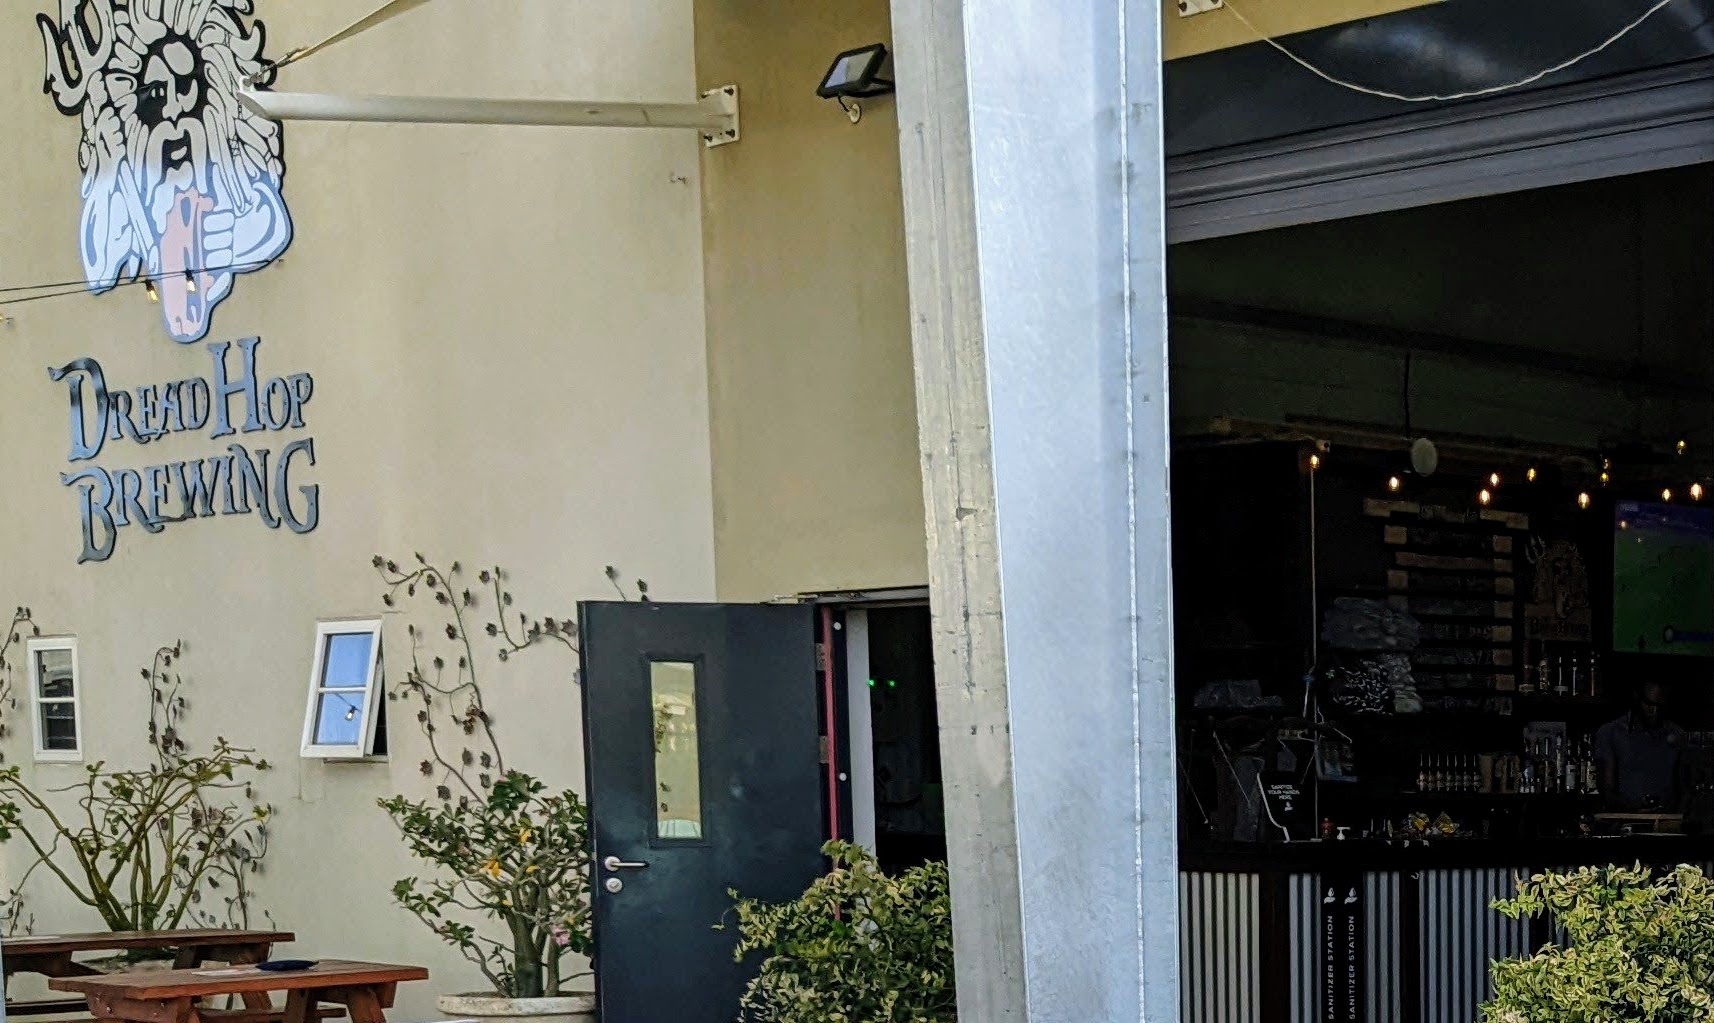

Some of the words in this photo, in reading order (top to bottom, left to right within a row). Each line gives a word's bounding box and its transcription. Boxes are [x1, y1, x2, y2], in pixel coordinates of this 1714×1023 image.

[59, 437, 319, 565] BREWING
[1327, 915, 1335, 961] STATION
[1348, 915, 1356, 961] STATION
[1327, 964, 1335, 1020] SANITIZER
[1348, 964, 1356, 1020] SANITIZER
